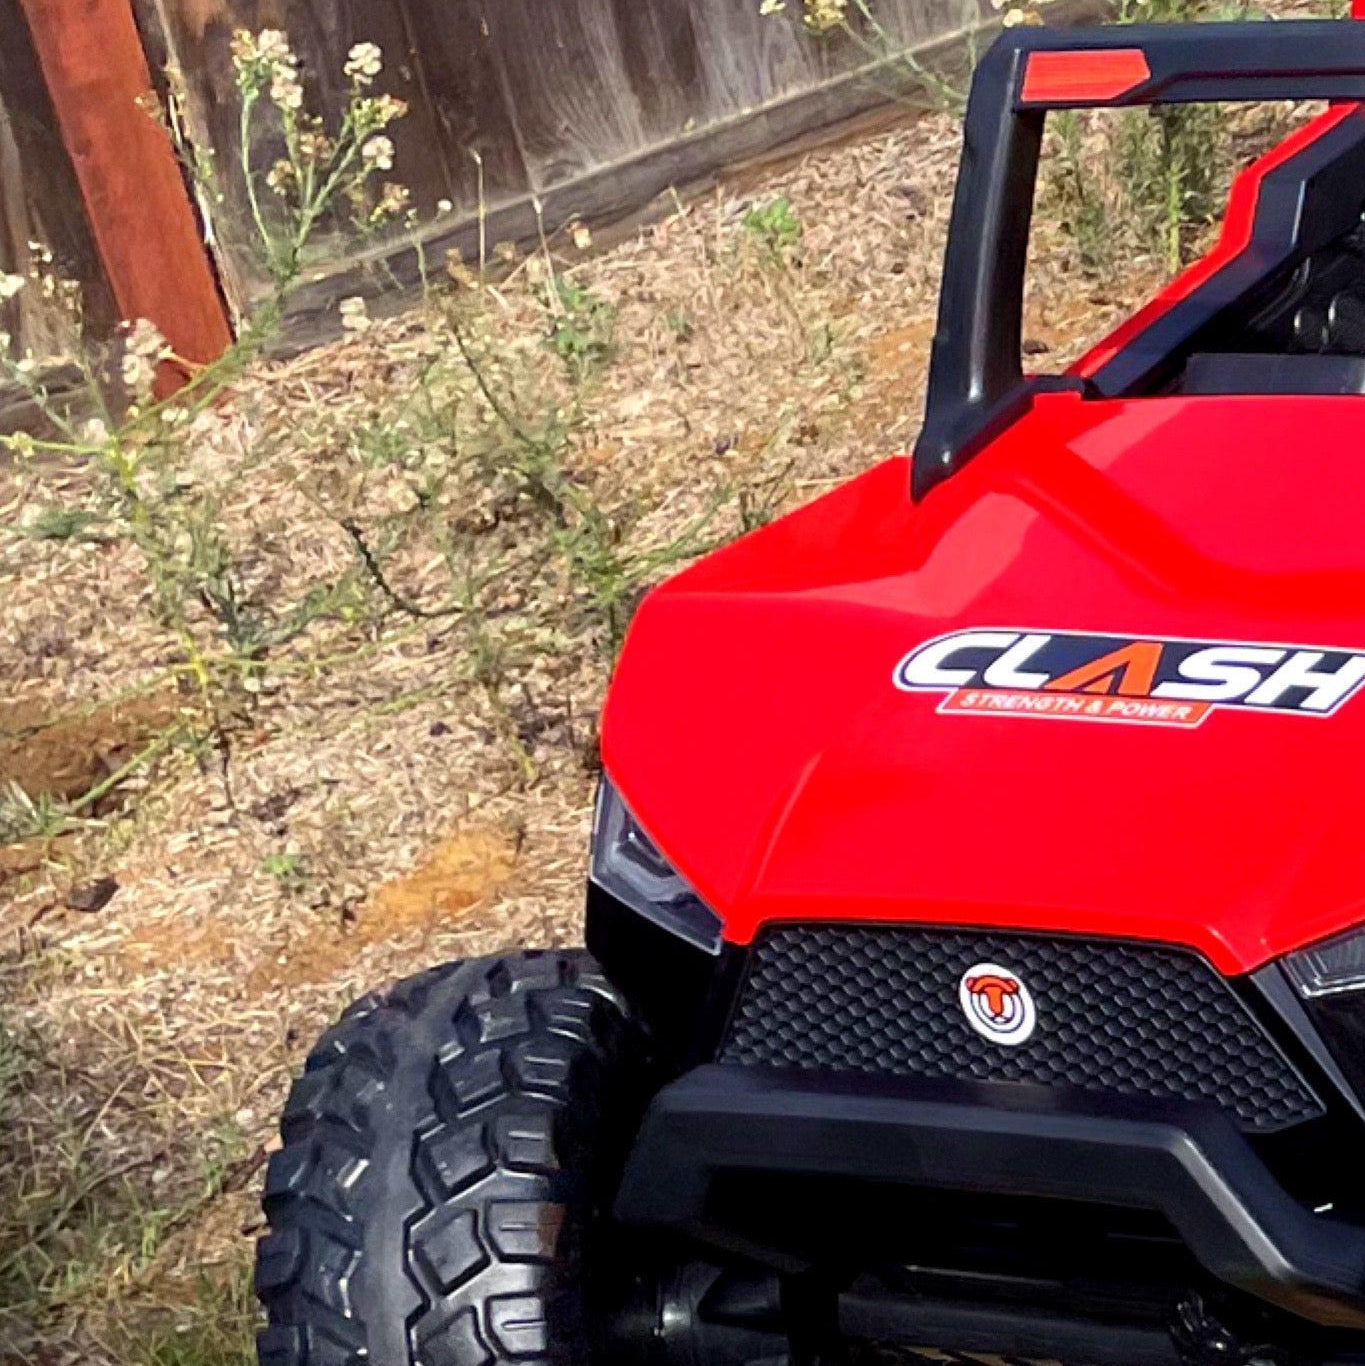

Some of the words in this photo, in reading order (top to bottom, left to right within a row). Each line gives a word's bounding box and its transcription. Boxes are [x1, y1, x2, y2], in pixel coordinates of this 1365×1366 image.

[961, 693, 1082, 713] STRENGTH
[1085, 699, 1102, 714] &
[1109, 701, 1192, 720] POWER
